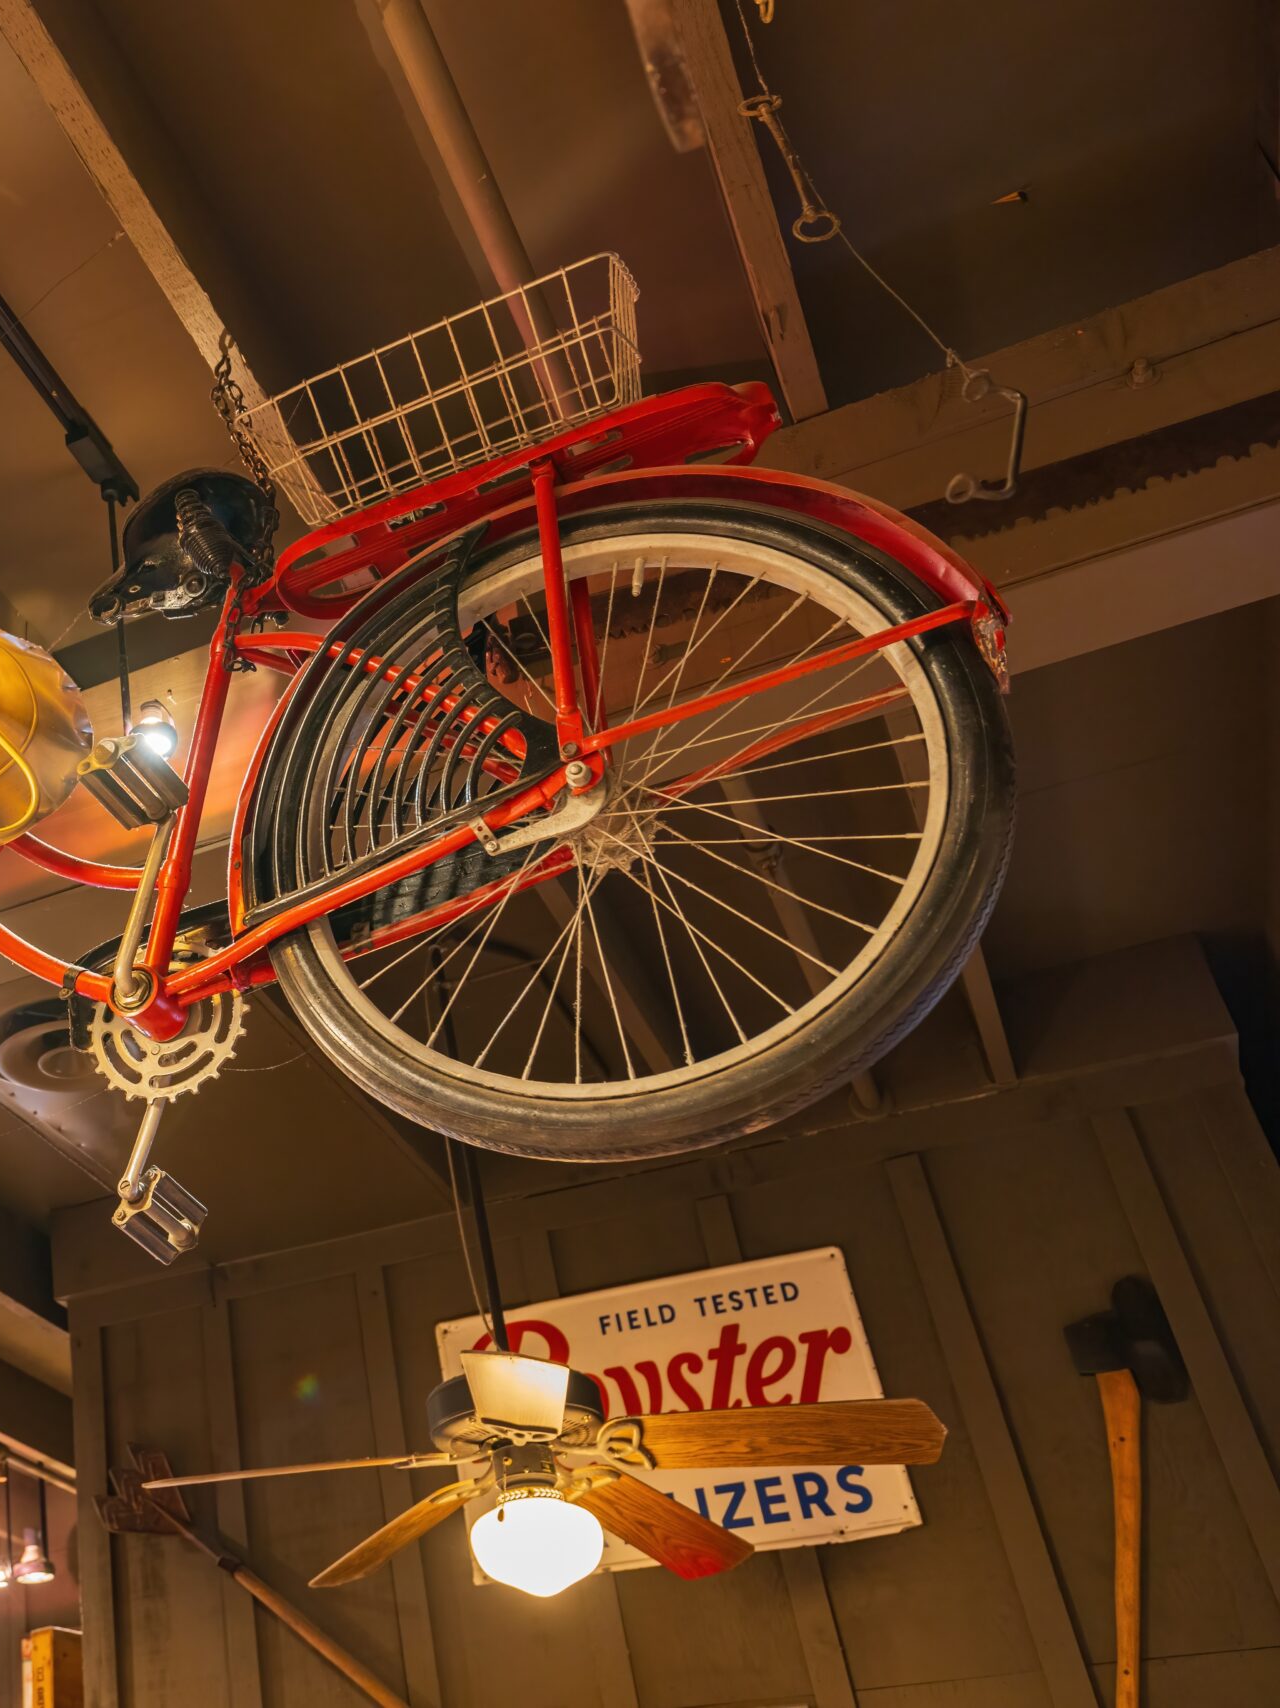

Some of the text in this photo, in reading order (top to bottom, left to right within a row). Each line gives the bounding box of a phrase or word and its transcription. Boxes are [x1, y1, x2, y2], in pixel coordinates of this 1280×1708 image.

[598, 1281, 800, 1336] FIELD TESTED
[664, 1464, 874, 1531] IZERS
